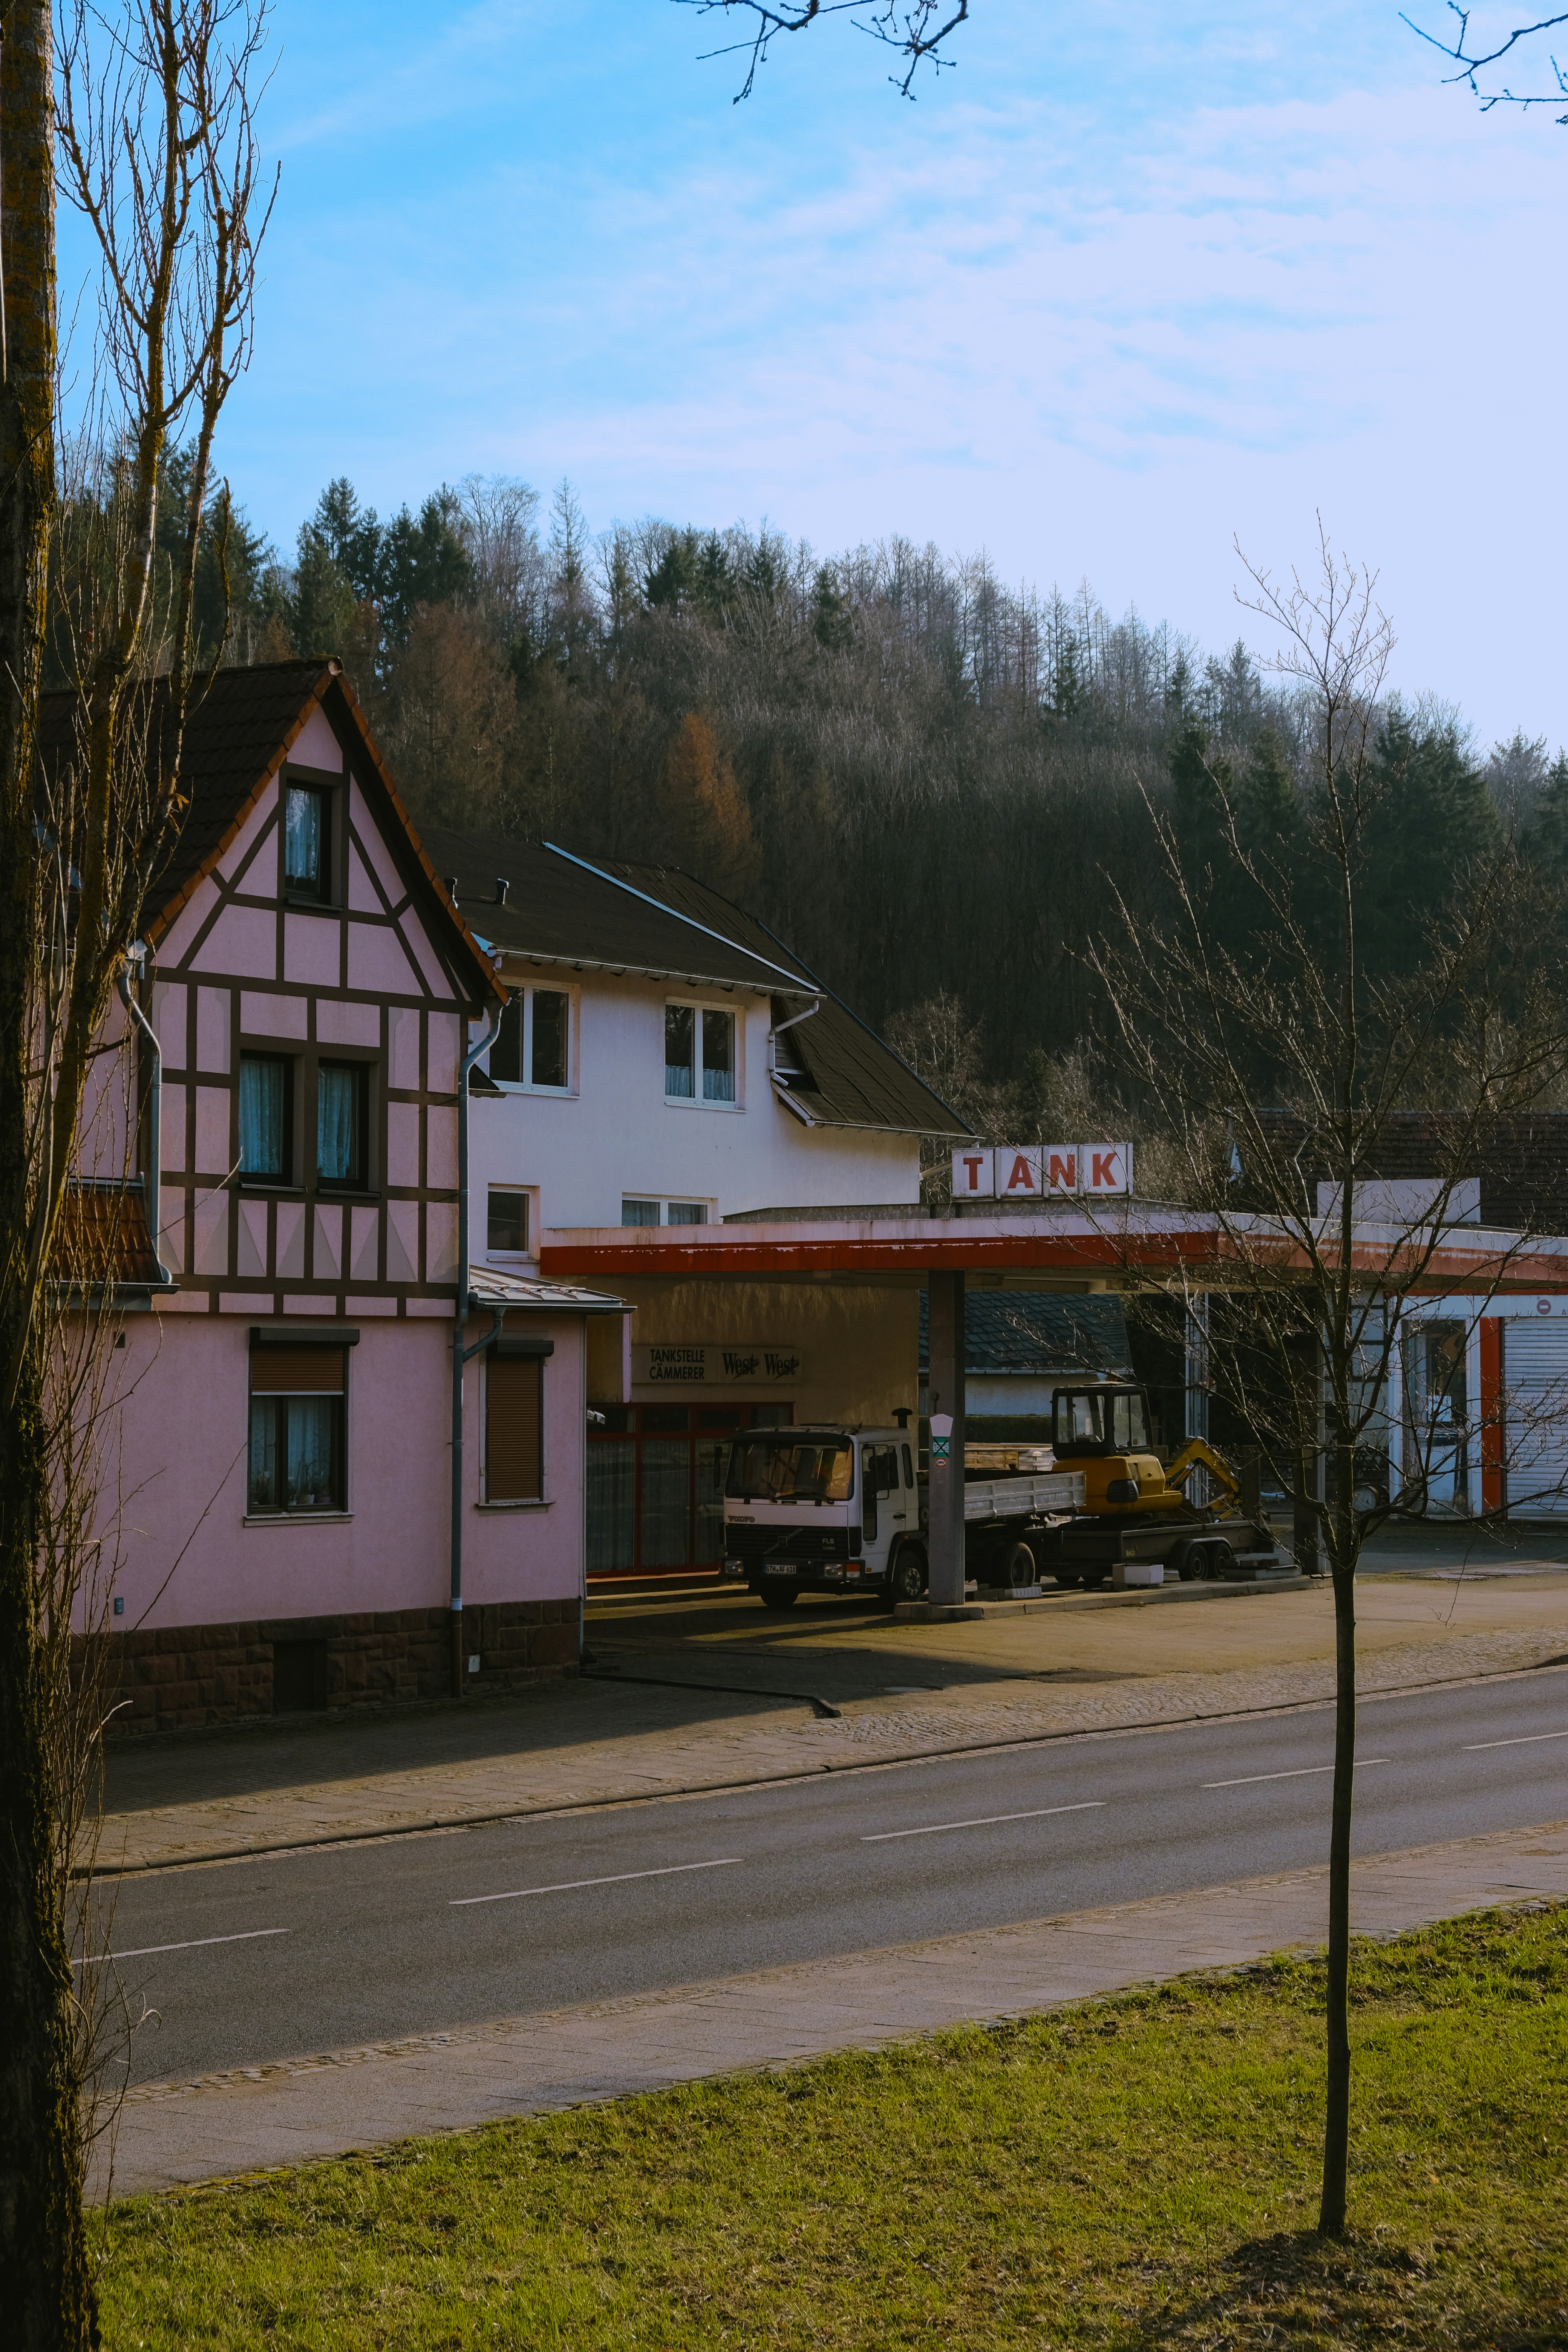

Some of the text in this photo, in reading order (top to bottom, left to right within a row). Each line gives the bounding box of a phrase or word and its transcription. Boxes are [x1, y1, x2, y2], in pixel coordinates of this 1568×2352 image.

[963, 1153, 1118, 1190] TANK
[650, 1349, 704, 1363] TANKSTELLE
[722, 1353, 756, 1375] West
[764, 1354, 796, 1376] West
[649, 1363, 704, 1380] CÄMMERER
